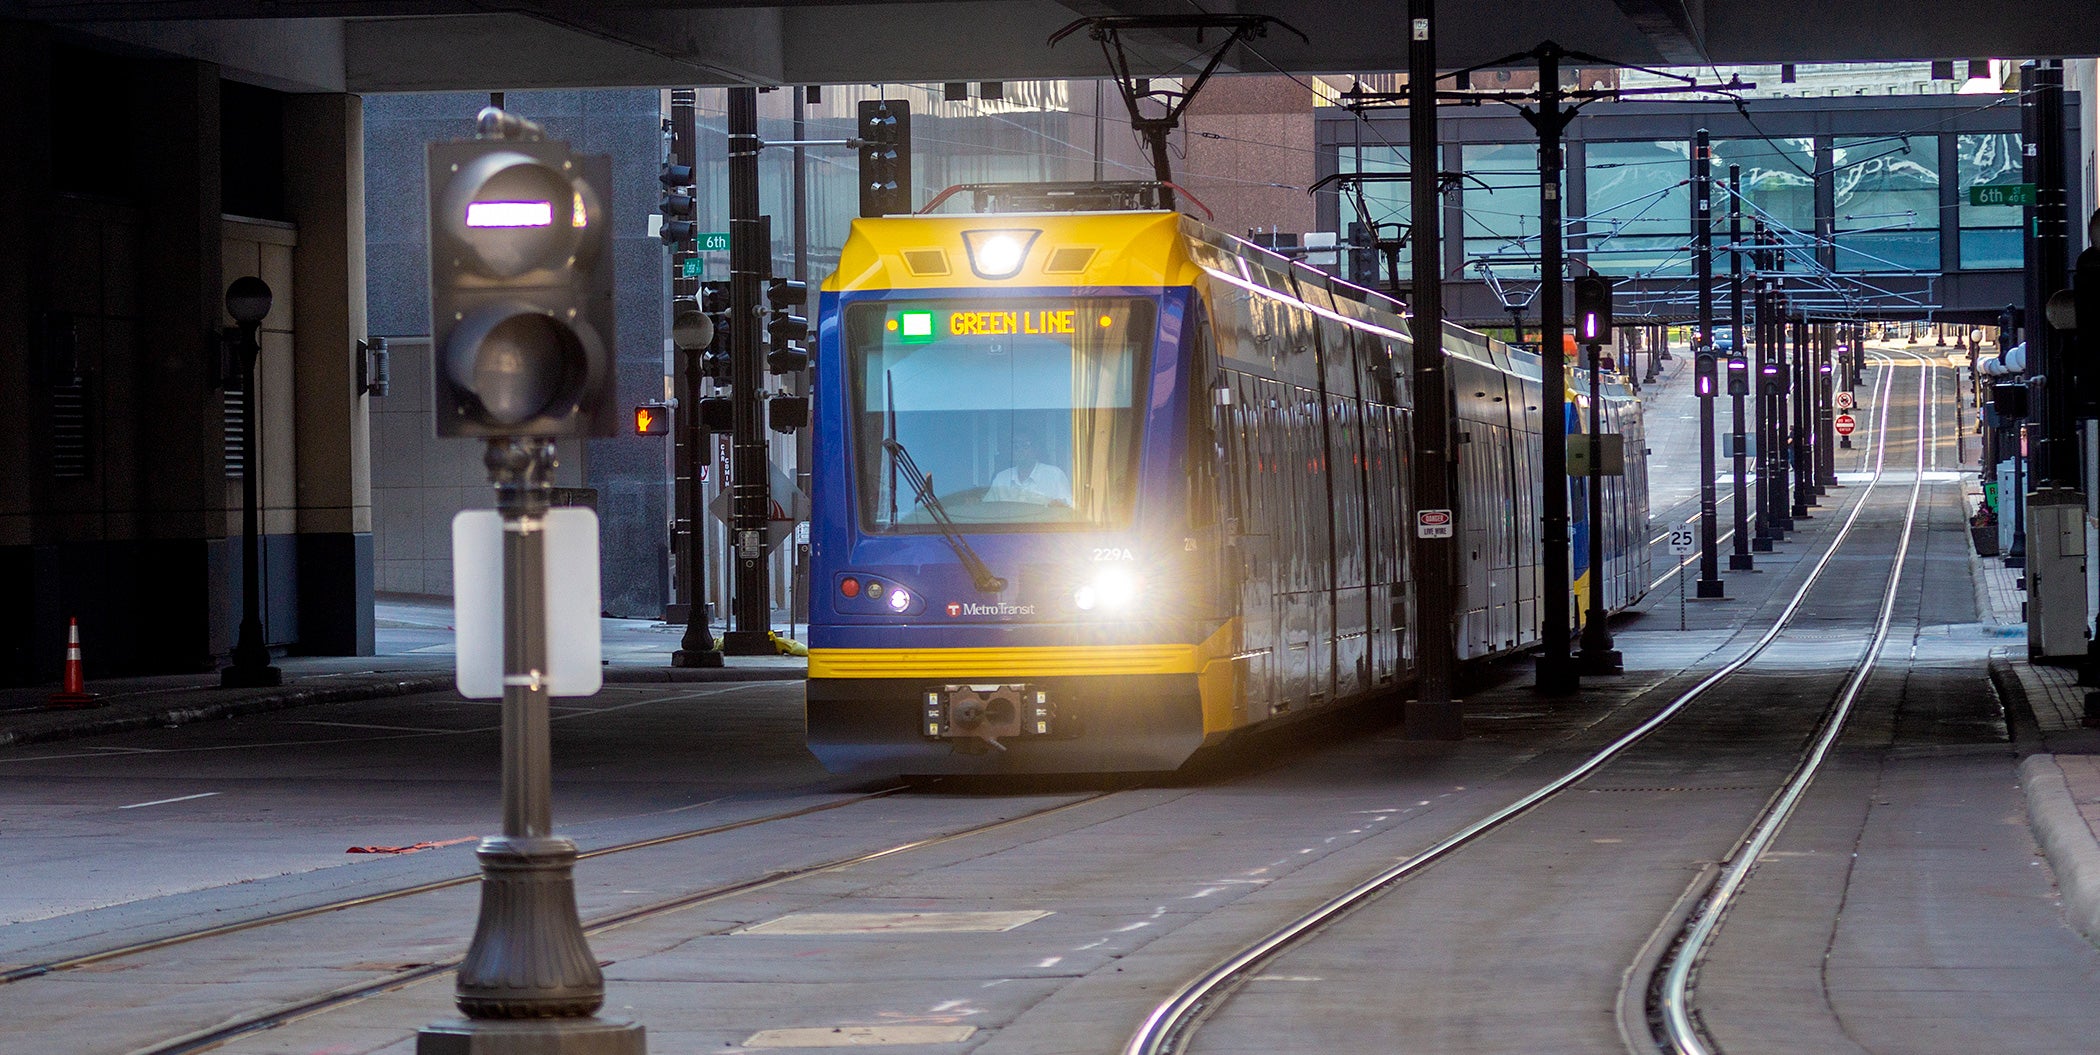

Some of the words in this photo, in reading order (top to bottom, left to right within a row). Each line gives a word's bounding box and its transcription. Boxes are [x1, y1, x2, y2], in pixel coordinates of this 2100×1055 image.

[1980, 189, 2003, 203] 6th
[706, 236, 726, 248] 6th
[950, 311, 1017, 335] GREEN
[1024, 310, 1075, 334] LINE
[1423, 527, 1434, 535] LIVE
[1435, 527, 1447, 535] WIRE
[1671, 531, 1692, 545] 25
[1093, 548, 1134, 560] 229A
